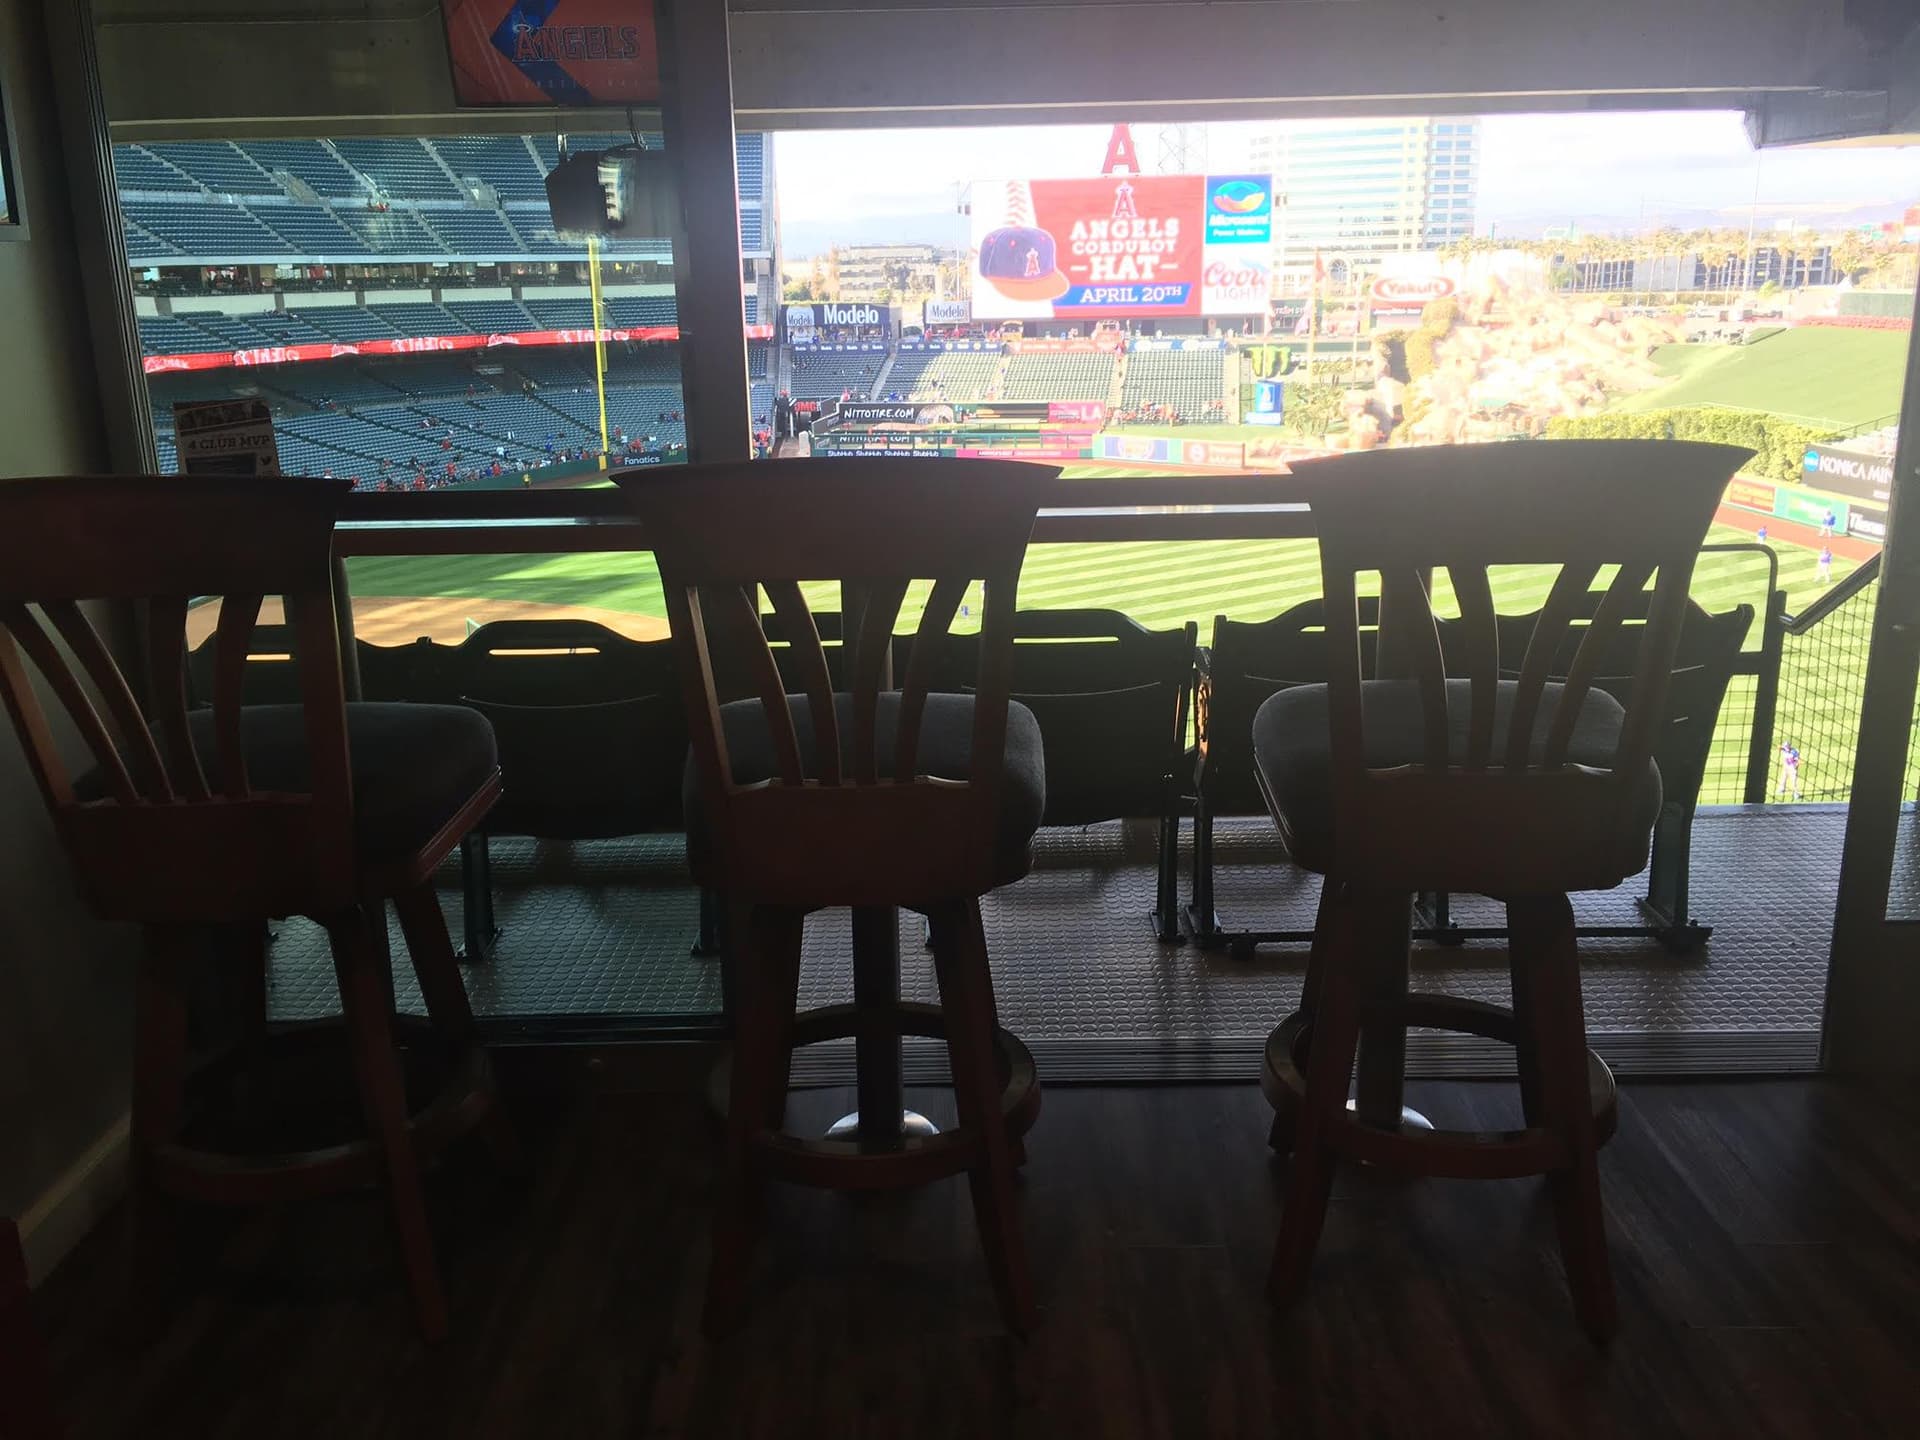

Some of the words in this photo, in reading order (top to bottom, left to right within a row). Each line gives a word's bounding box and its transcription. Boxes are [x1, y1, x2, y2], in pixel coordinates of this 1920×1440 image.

[512, 22, 640, 62] ANGELS
[1101, 122, 1141, 174] A
[1069, 218, 1180, 241] ANGELS
[1071, 239, 1177, 255] CORDUROY
[1080, 287, 1139, 303] APRIL
[1142, 285, 1183, 302] 20TH
[1387, 280, 1441, 295] Yakult
[823, 304, 880, 325] Modelo
[931, 304, 966, 318] Modelo
[844, 407, 914, 419] NITTOTIRE.COM
[200, 438, 236, 450] CLUB
[240, 435, 271, 447] MVP
[624, 455, 661, 465] Fanatics
[1819, 456, 1866, 480] KONICA
